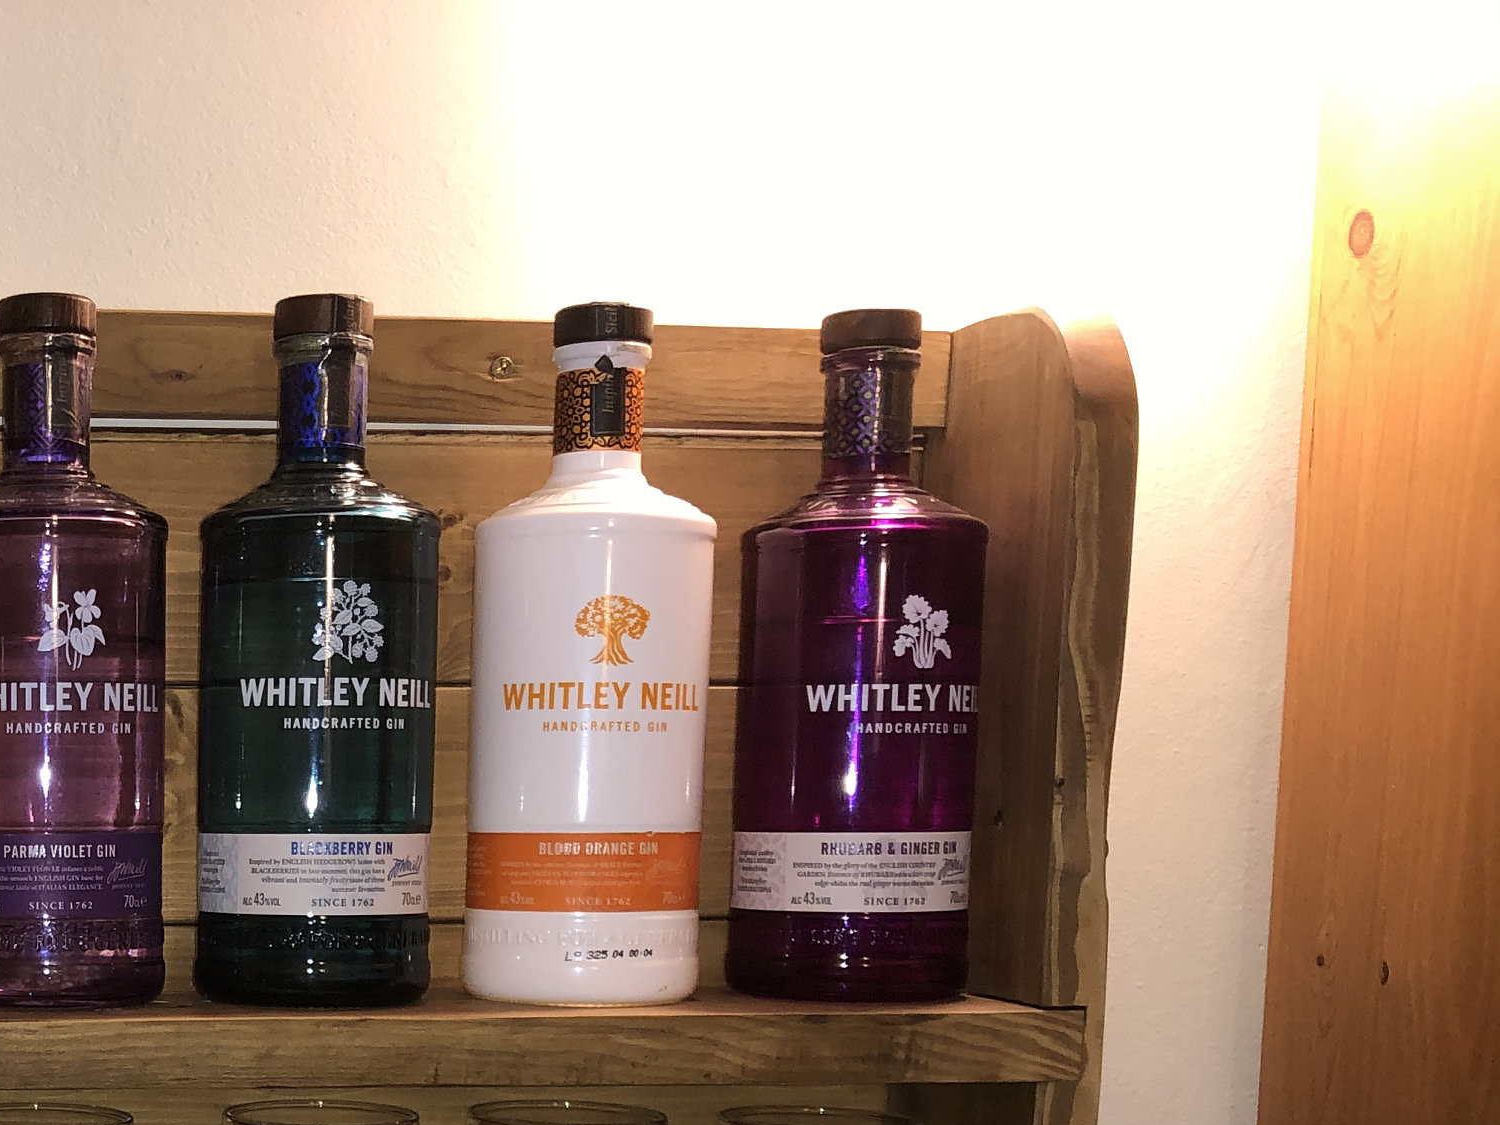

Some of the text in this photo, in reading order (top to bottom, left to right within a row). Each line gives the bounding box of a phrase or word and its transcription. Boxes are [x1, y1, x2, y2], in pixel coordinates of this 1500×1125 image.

[103, 682, 159, 712] NEILL
[240, 677, 431, 709] WHITLEY NEILL
[503, 682, 699, 711] WHITLEY NEILL
[805, 683, 941, 712] WHITLEY
[6, 722, 131, 734] HANDCRAFTED GIN
[283, 717, 404, 729] HANDCRAFTED GIN
[542, 721, 668, 732] HANDCRAFTED GIN
[856, 722, 968, 734] HANDCRAFTED GIN
[3, 844, 116, 858] PARMA VIOLET GIN
[291, 841, 393, 855] BLACKBERRY GIN
[538, 842, 658, 855] BLOOD ORANGE GIN
[821, 841, 957, 855] RHUBARB & GINGER GIN
[29, 900, 93, 910] SINCE 1762
[311, 898, 375, 907] SINCE 1762
[565, 897, 631, 906] SINCE 1762
[863, 897, 899, 906] SINCE
[586, 950, 608, 960] 325
